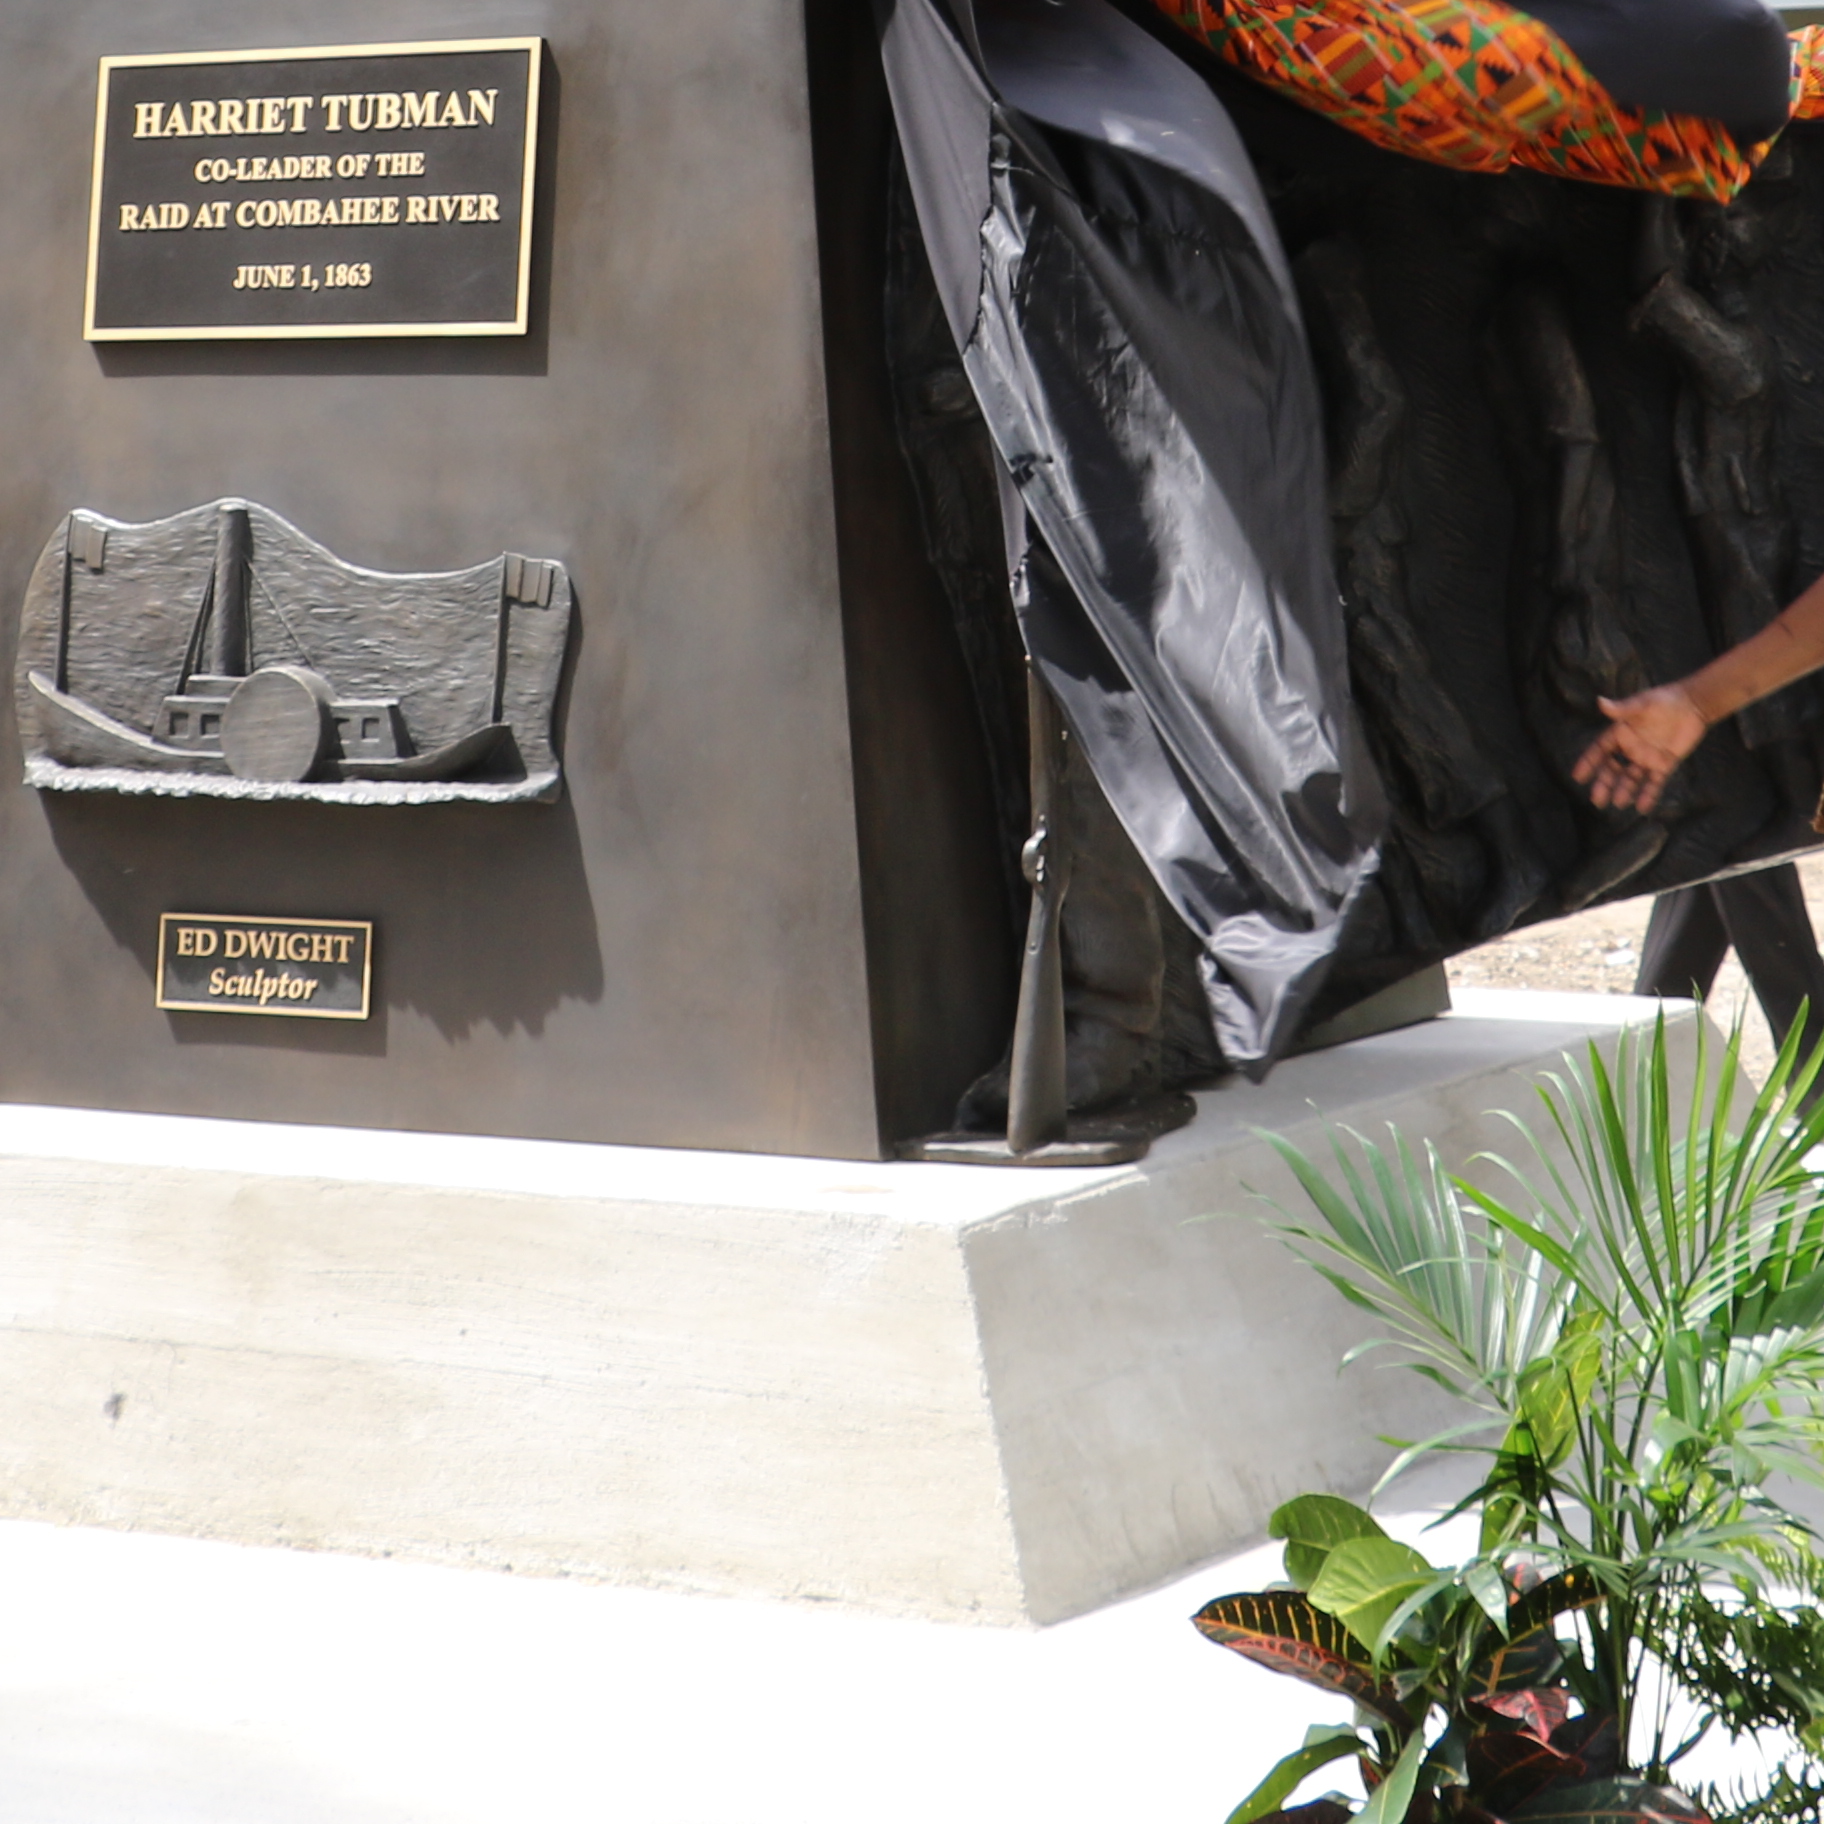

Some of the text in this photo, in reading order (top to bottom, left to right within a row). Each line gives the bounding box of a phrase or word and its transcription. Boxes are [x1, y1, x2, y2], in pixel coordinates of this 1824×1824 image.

[132, 88, 499, 139] HARRIET TUBMAN
[194, 152, 425, 183] CO-LEADER OF THE
[119, 193, 500, 231] RAID AT COMBAHEE RIVER
[232, 262, 372, 292] JUNE 1, 1863
[176, 927, 355, 964] ED DWIGHT
[208, 966, 319, 1006] Sculptor
